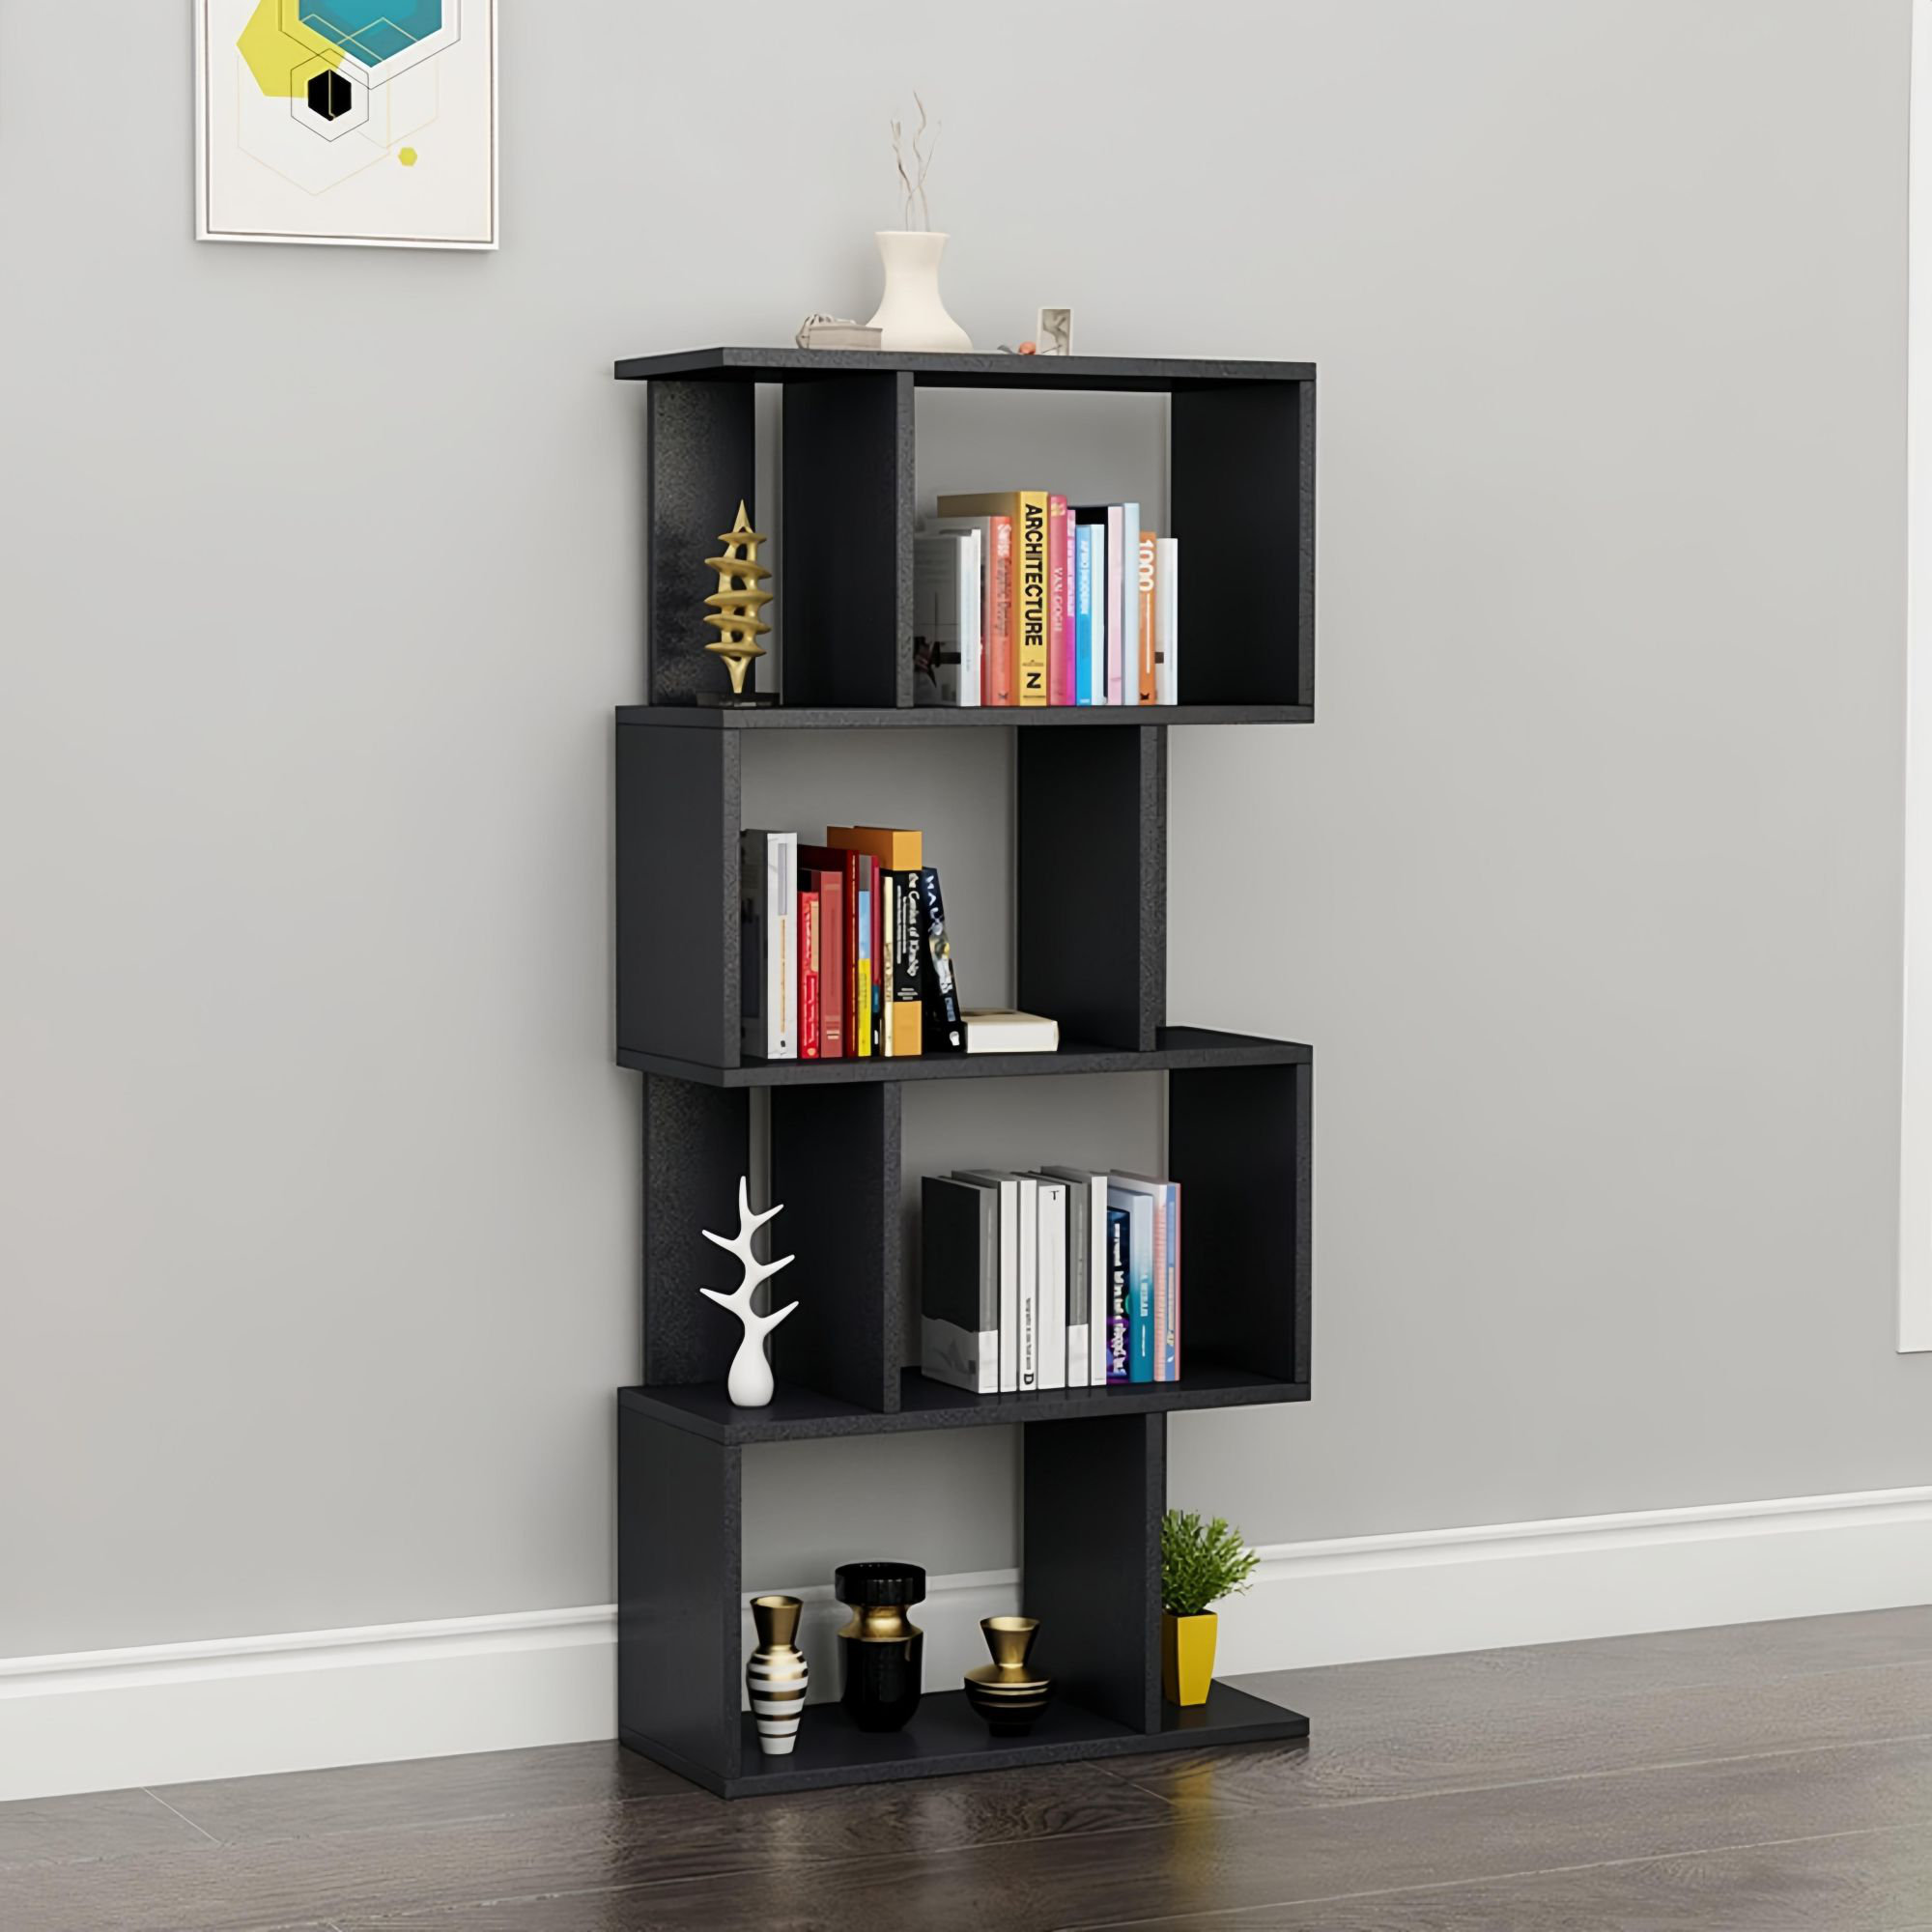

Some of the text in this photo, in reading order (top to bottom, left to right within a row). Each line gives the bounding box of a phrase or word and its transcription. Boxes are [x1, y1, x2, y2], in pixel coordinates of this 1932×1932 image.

[1024, 503, 1043, 646] ARCHITECTURE
[1139, 539, 1154, 591] 1000
[1053, 567, 1064, 632] VAN GOGH
